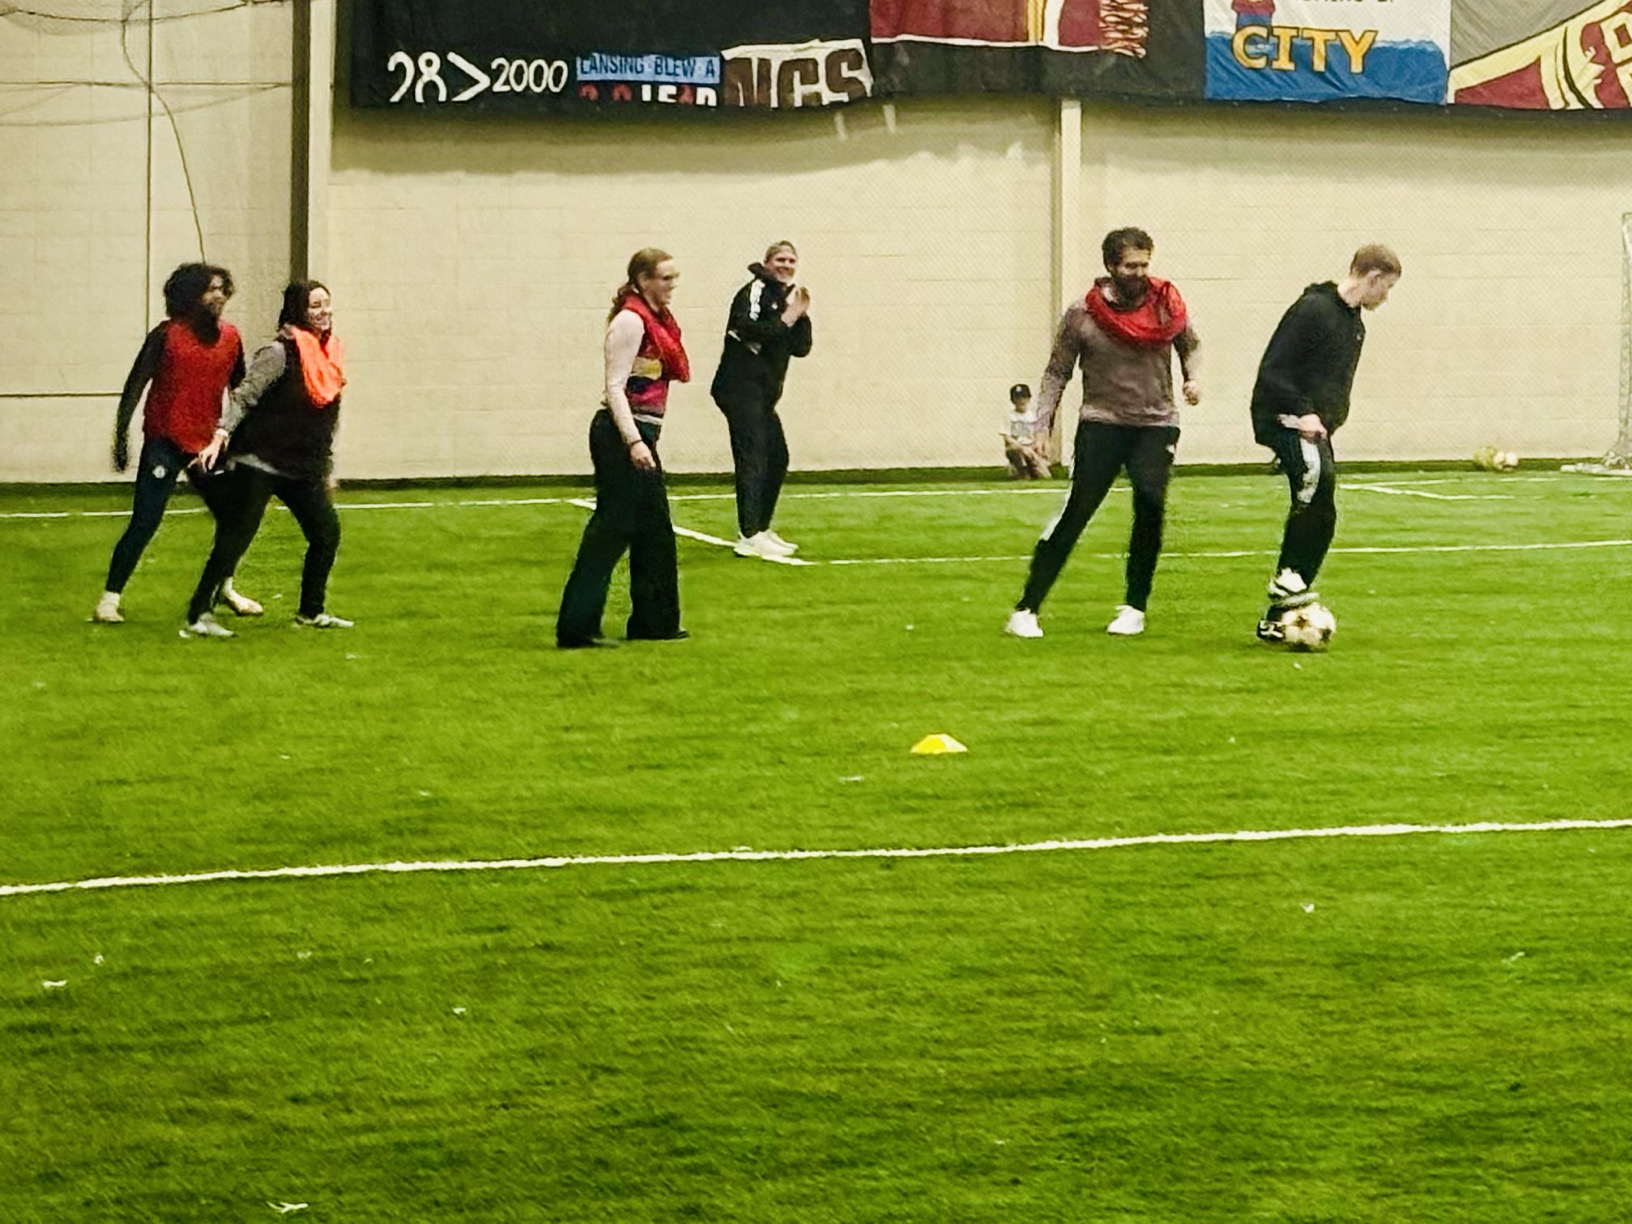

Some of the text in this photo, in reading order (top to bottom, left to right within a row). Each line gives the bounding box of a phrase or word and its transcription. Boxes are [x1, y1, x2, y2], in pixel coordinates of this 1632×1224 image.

[579, 54, 716, 78] LANSING BLEW A
[1231, 25, 1379, 74] CITY
